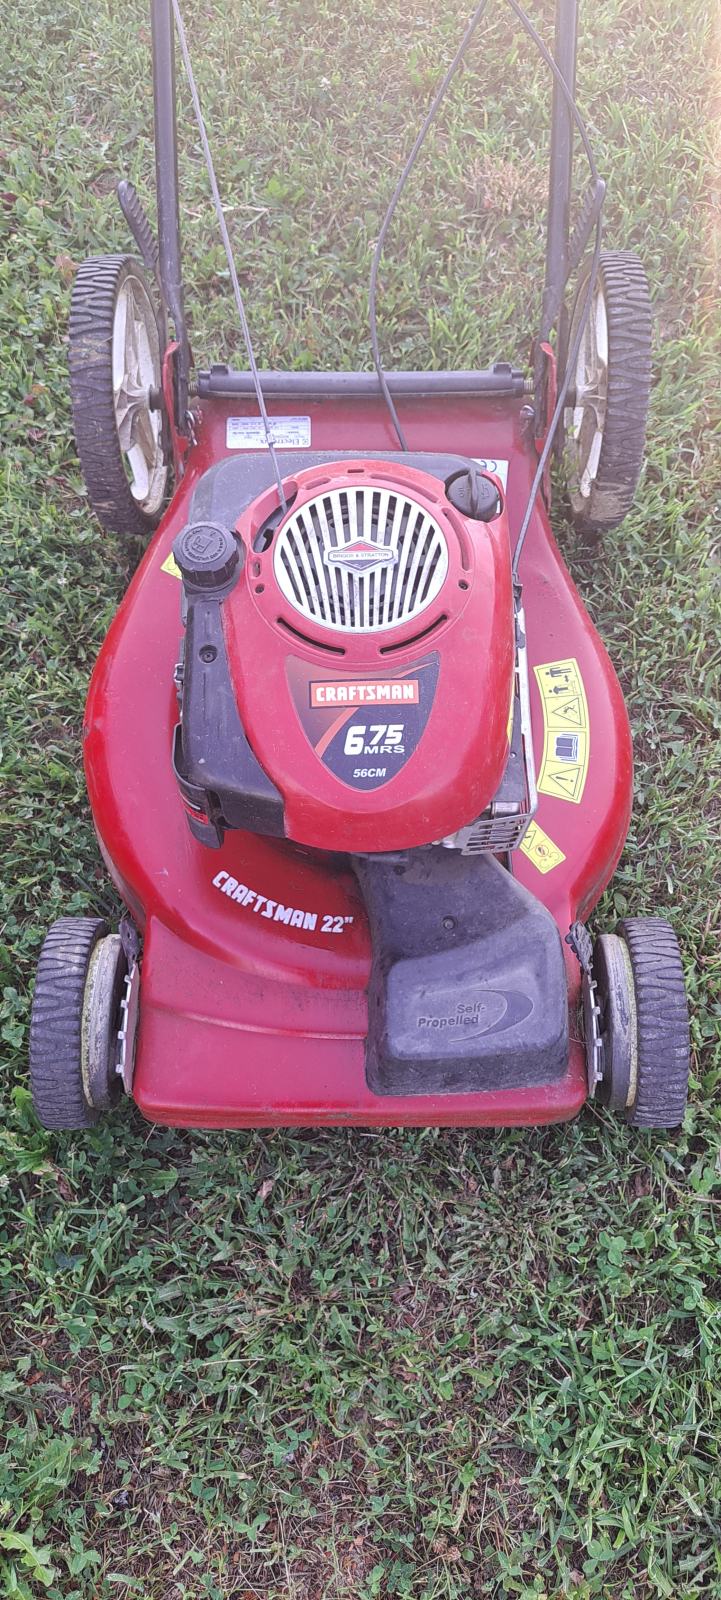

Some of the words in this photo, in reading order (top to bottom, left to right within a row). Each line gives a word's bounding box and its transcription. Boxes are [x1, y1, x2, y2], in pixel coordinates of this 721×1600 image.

[260, 438, 300, 446] Electrux
[315, 684, 414, 702] CRAFTSMAN
[363, 745, 405, 755] MRS
[353, 767, 387, 778] 56CM
[211, 870, 319, 931] CRAFTSMAN
[320, 915, 354, 934] 22"
[456, 1002, 486, 1014] Self-
[417, 1014, 479, 1029] Propelled
